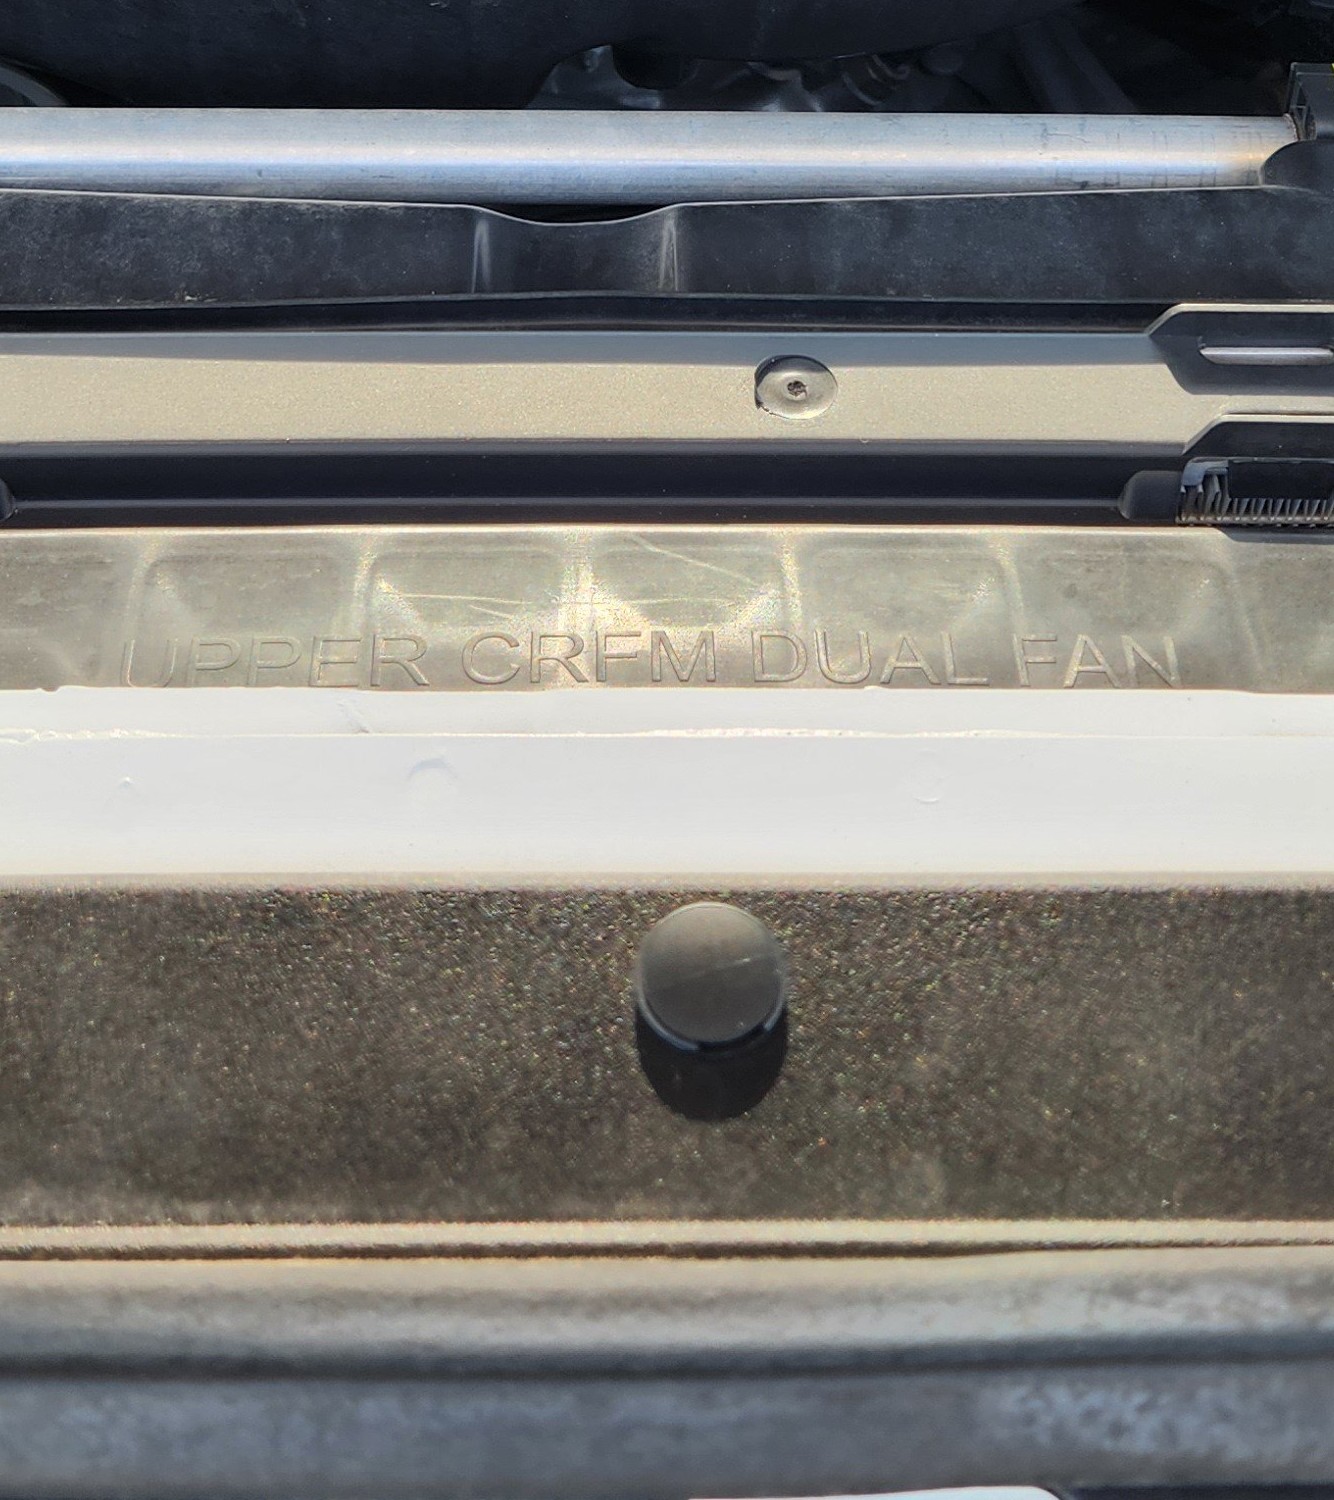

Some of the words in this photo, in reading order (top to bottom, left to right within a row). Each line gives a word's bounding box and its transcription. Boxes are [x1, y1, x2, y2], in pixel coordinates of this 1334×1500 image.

[121, 632, 430, 687] UPPER
[461, 629, 717, 684] CRFM
[751, 628, 989, 685] DUAL
[1012, 632, 1182, 688] FAN
